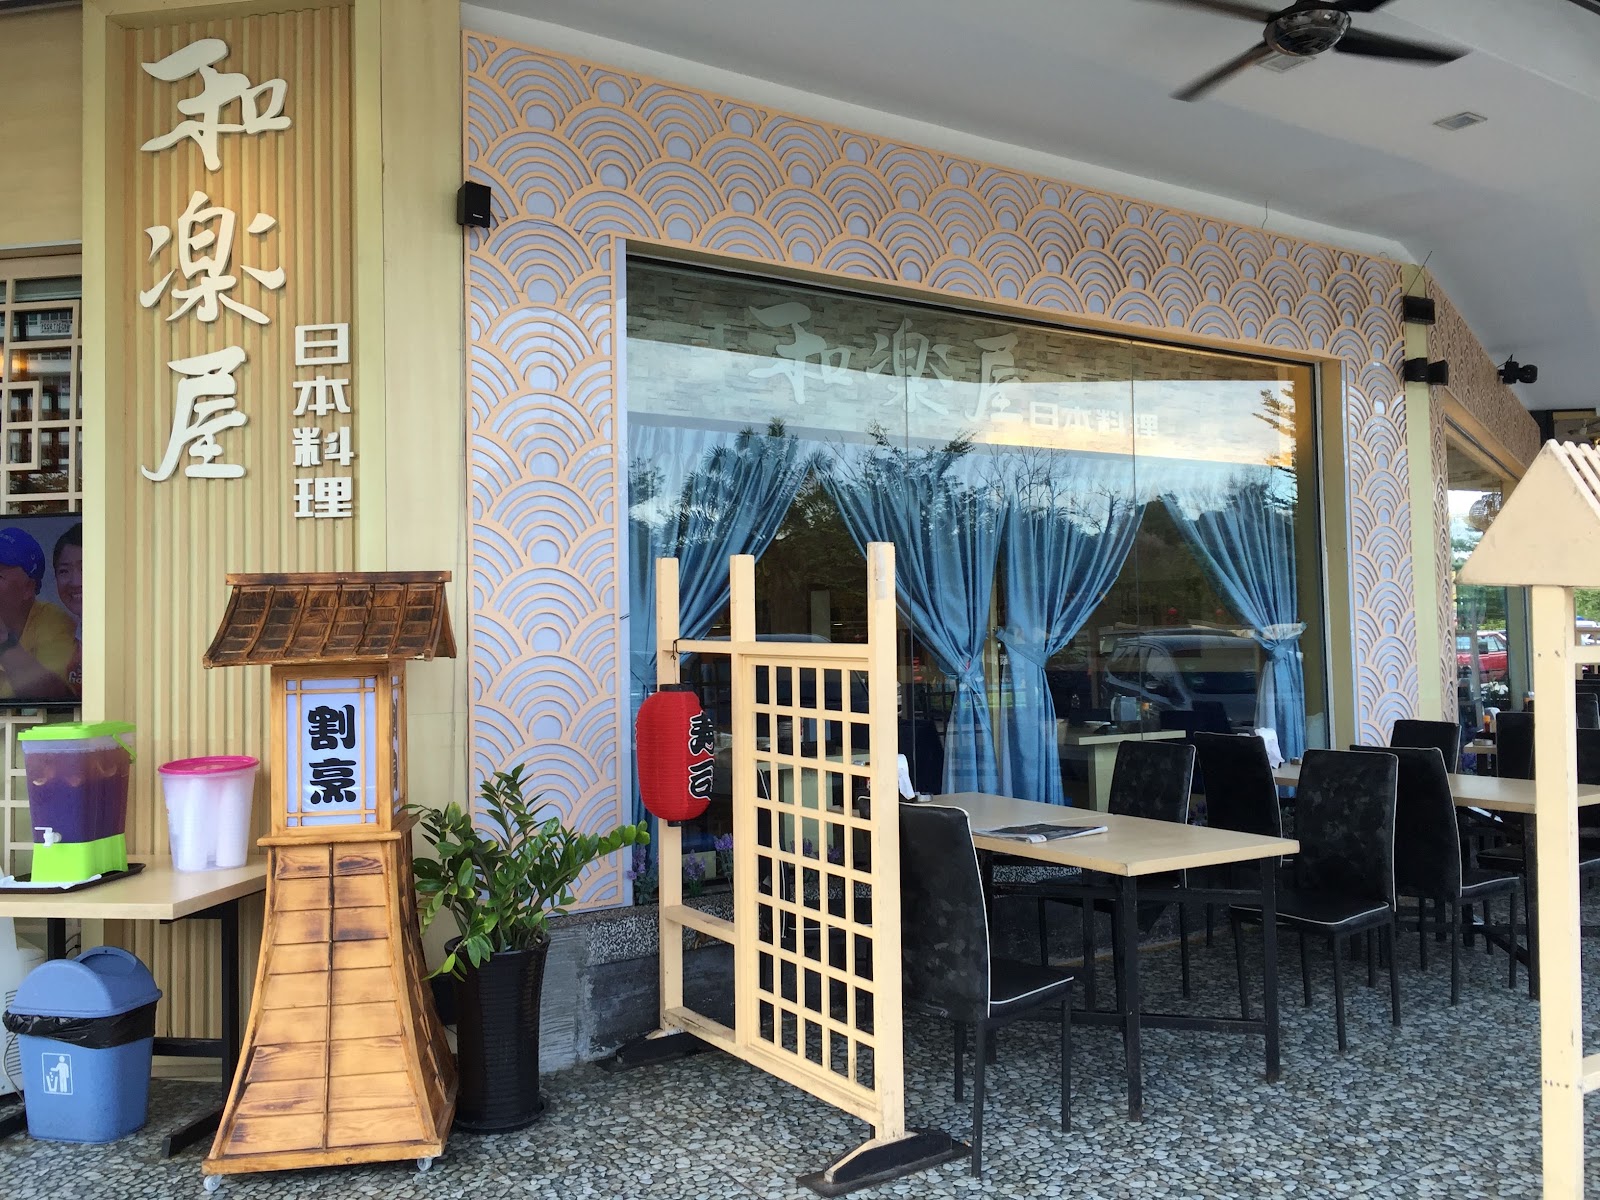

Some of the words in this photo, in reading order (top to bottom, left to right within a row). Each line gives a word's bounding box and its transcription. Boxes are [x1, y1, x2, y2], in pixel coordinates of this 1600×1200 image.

[292, 322, 357, 519] 日本料理
[307, 704, 356, 805] 割烹
